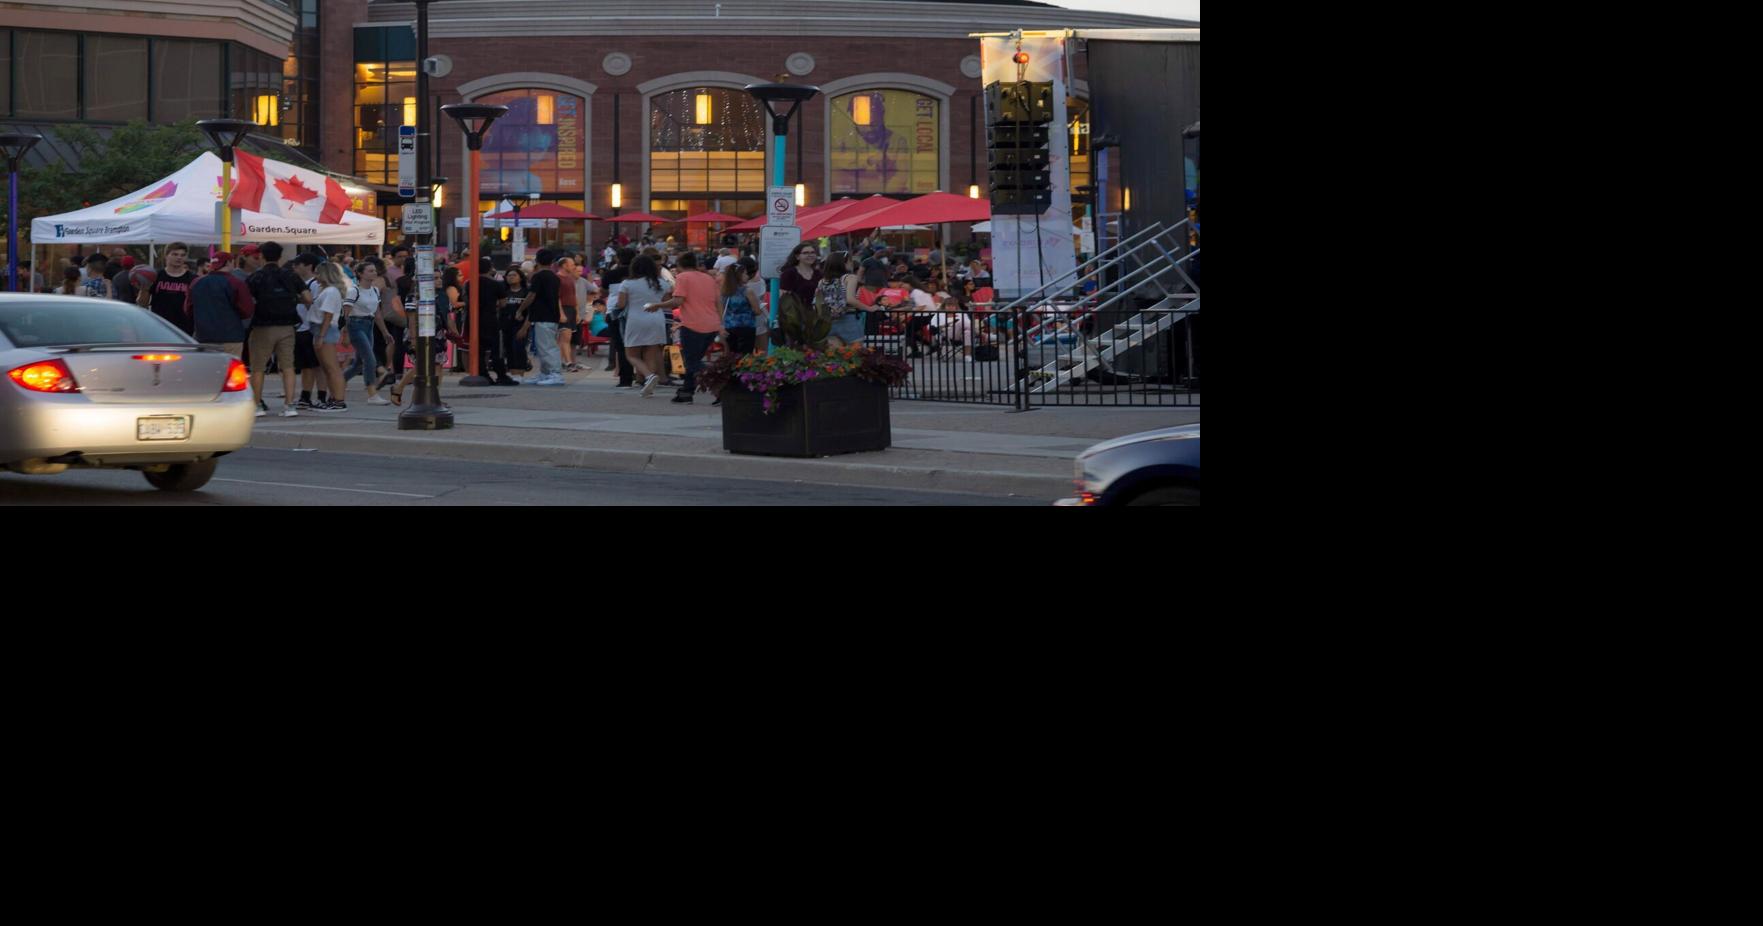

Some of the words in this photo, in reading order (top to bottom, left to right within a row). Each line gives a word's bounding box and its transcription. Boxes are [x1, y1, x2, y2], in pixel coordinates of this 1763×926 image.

[916, 99, 933, 118] GET
[558, 118, 576, 168] INSPIRED
[916, 121, 933, 154] LOCAL
[86, 226, 103, 235] Square
[248, 226, 317, 234] Garden.Square
